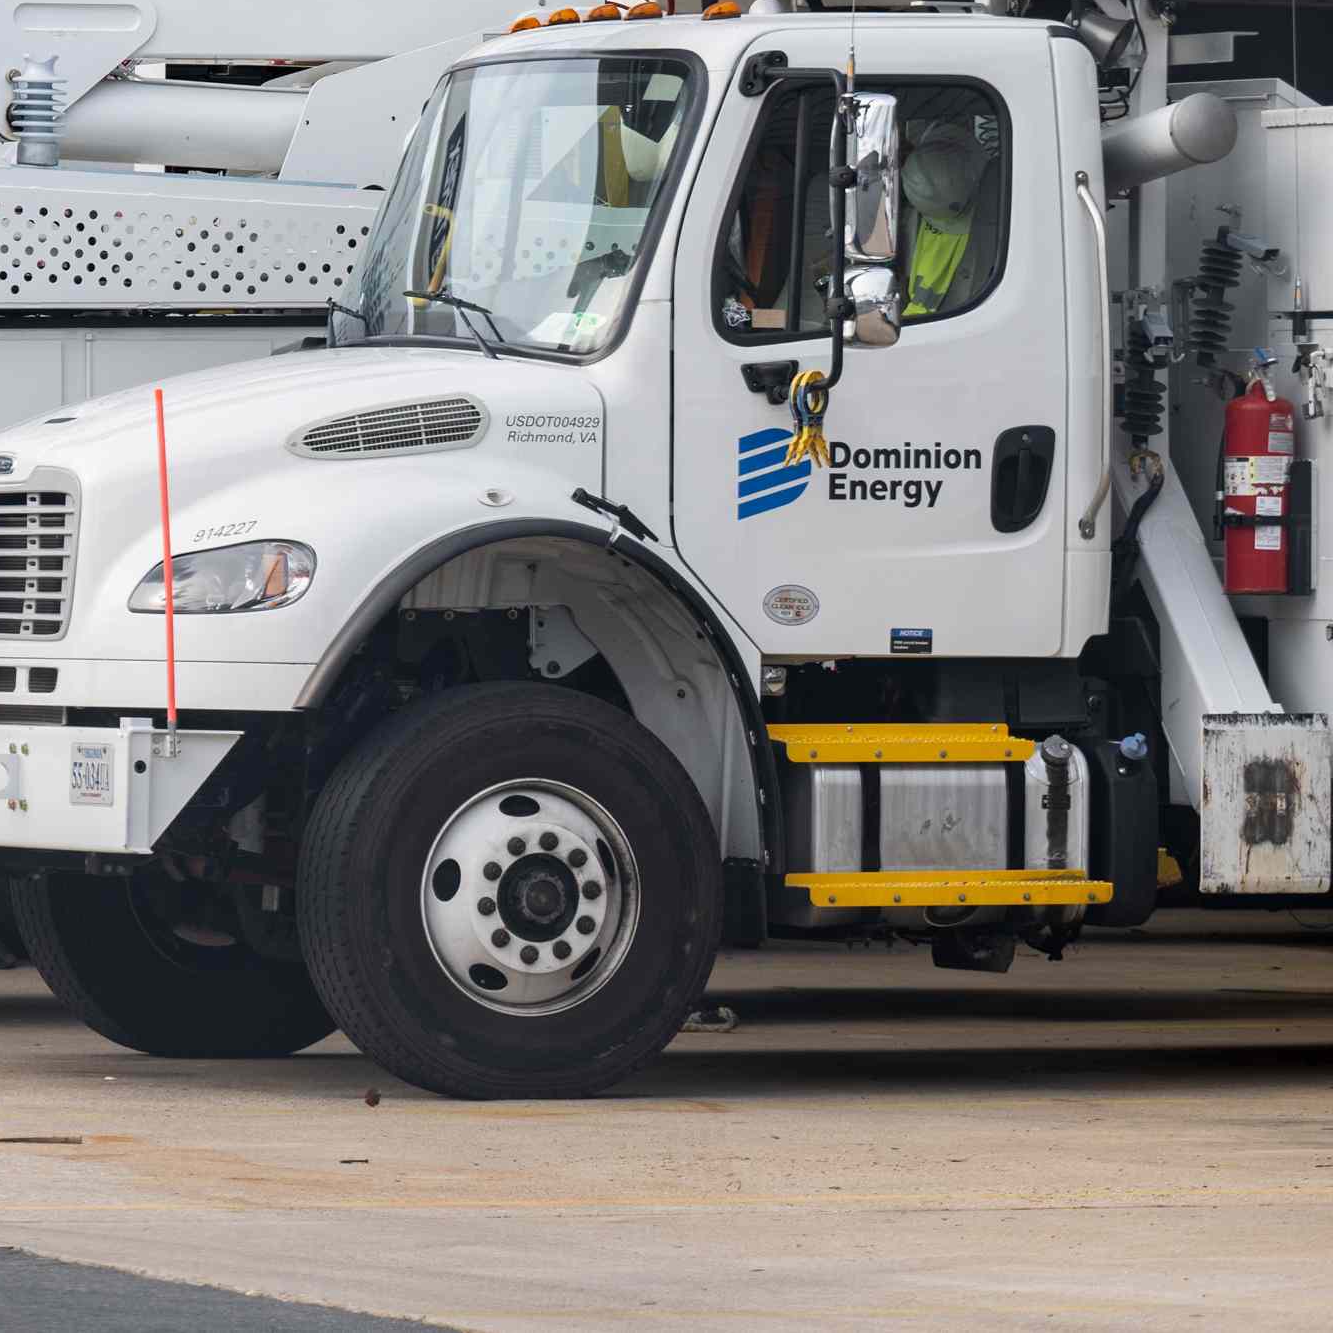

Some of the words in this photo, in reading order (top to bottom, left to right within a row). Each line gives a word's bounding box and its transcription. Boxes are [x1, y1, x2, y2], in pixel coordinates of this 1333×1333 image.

[506, 415, 600, 428] USDOT004929
[507, 430, 576, 445] Richmond,
[580, 432, 597, 443] VA
[829, 441, 982, 470] Dominion
[829, 473, 943, 508] Energy
[193, 520, 258, 543] 914227
